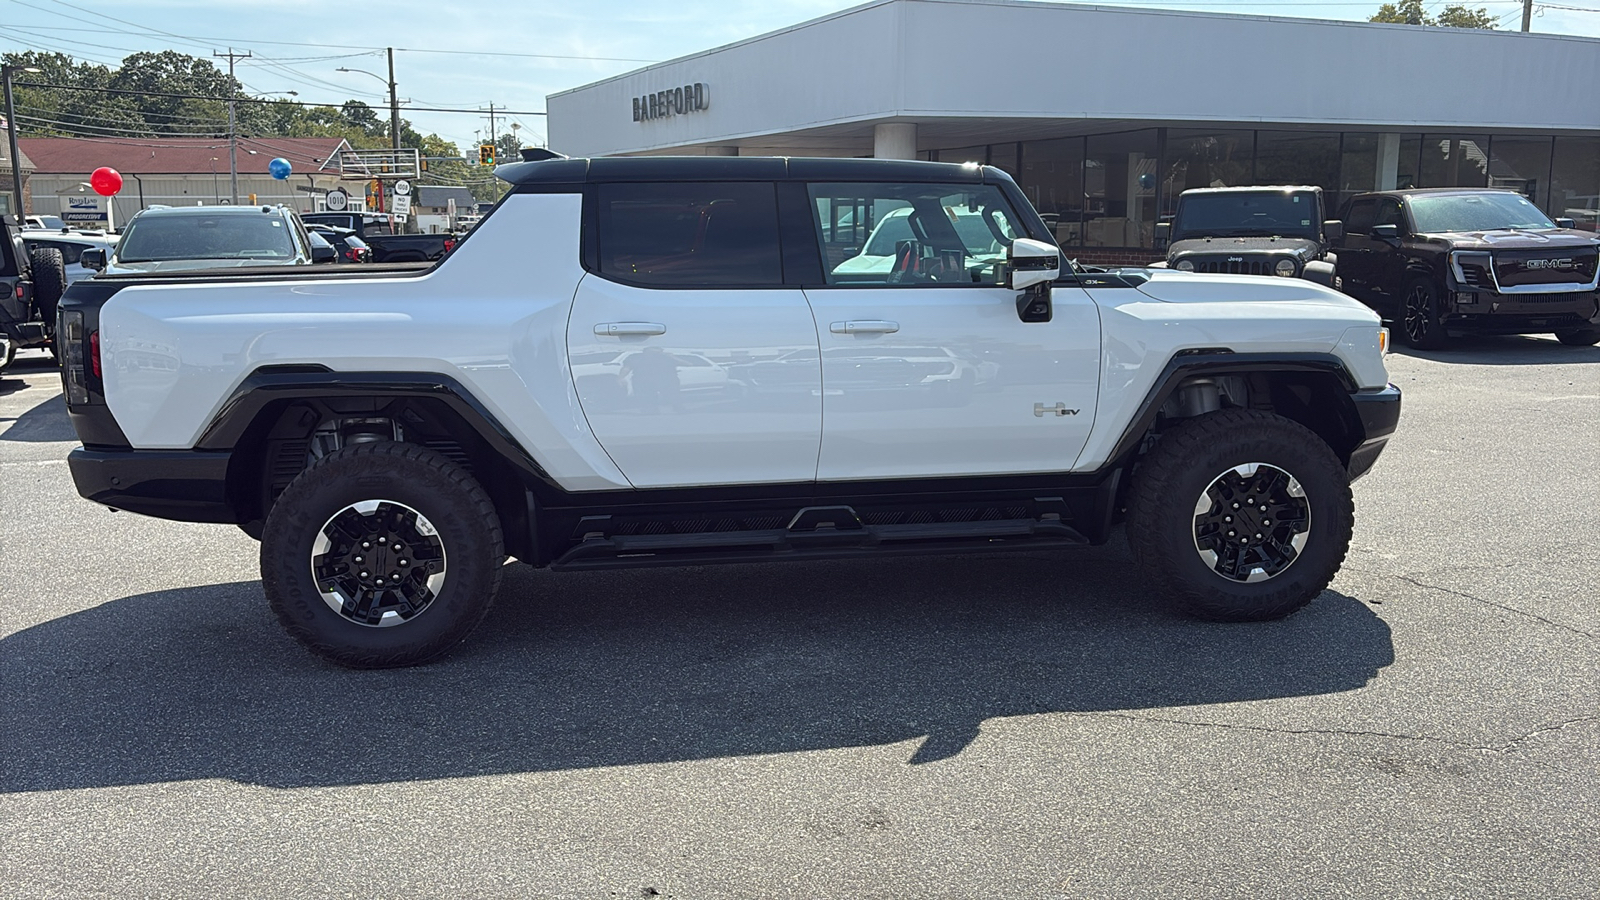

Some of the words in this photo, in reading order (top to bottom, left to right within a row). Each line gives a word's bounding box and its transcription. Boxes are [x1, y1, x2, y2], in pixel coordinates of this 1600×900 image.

[632, 82, 710, 122] BAREFORD
[329, 196, 344, 204] 1010
[1526, 258, 1572, 269] GMC
